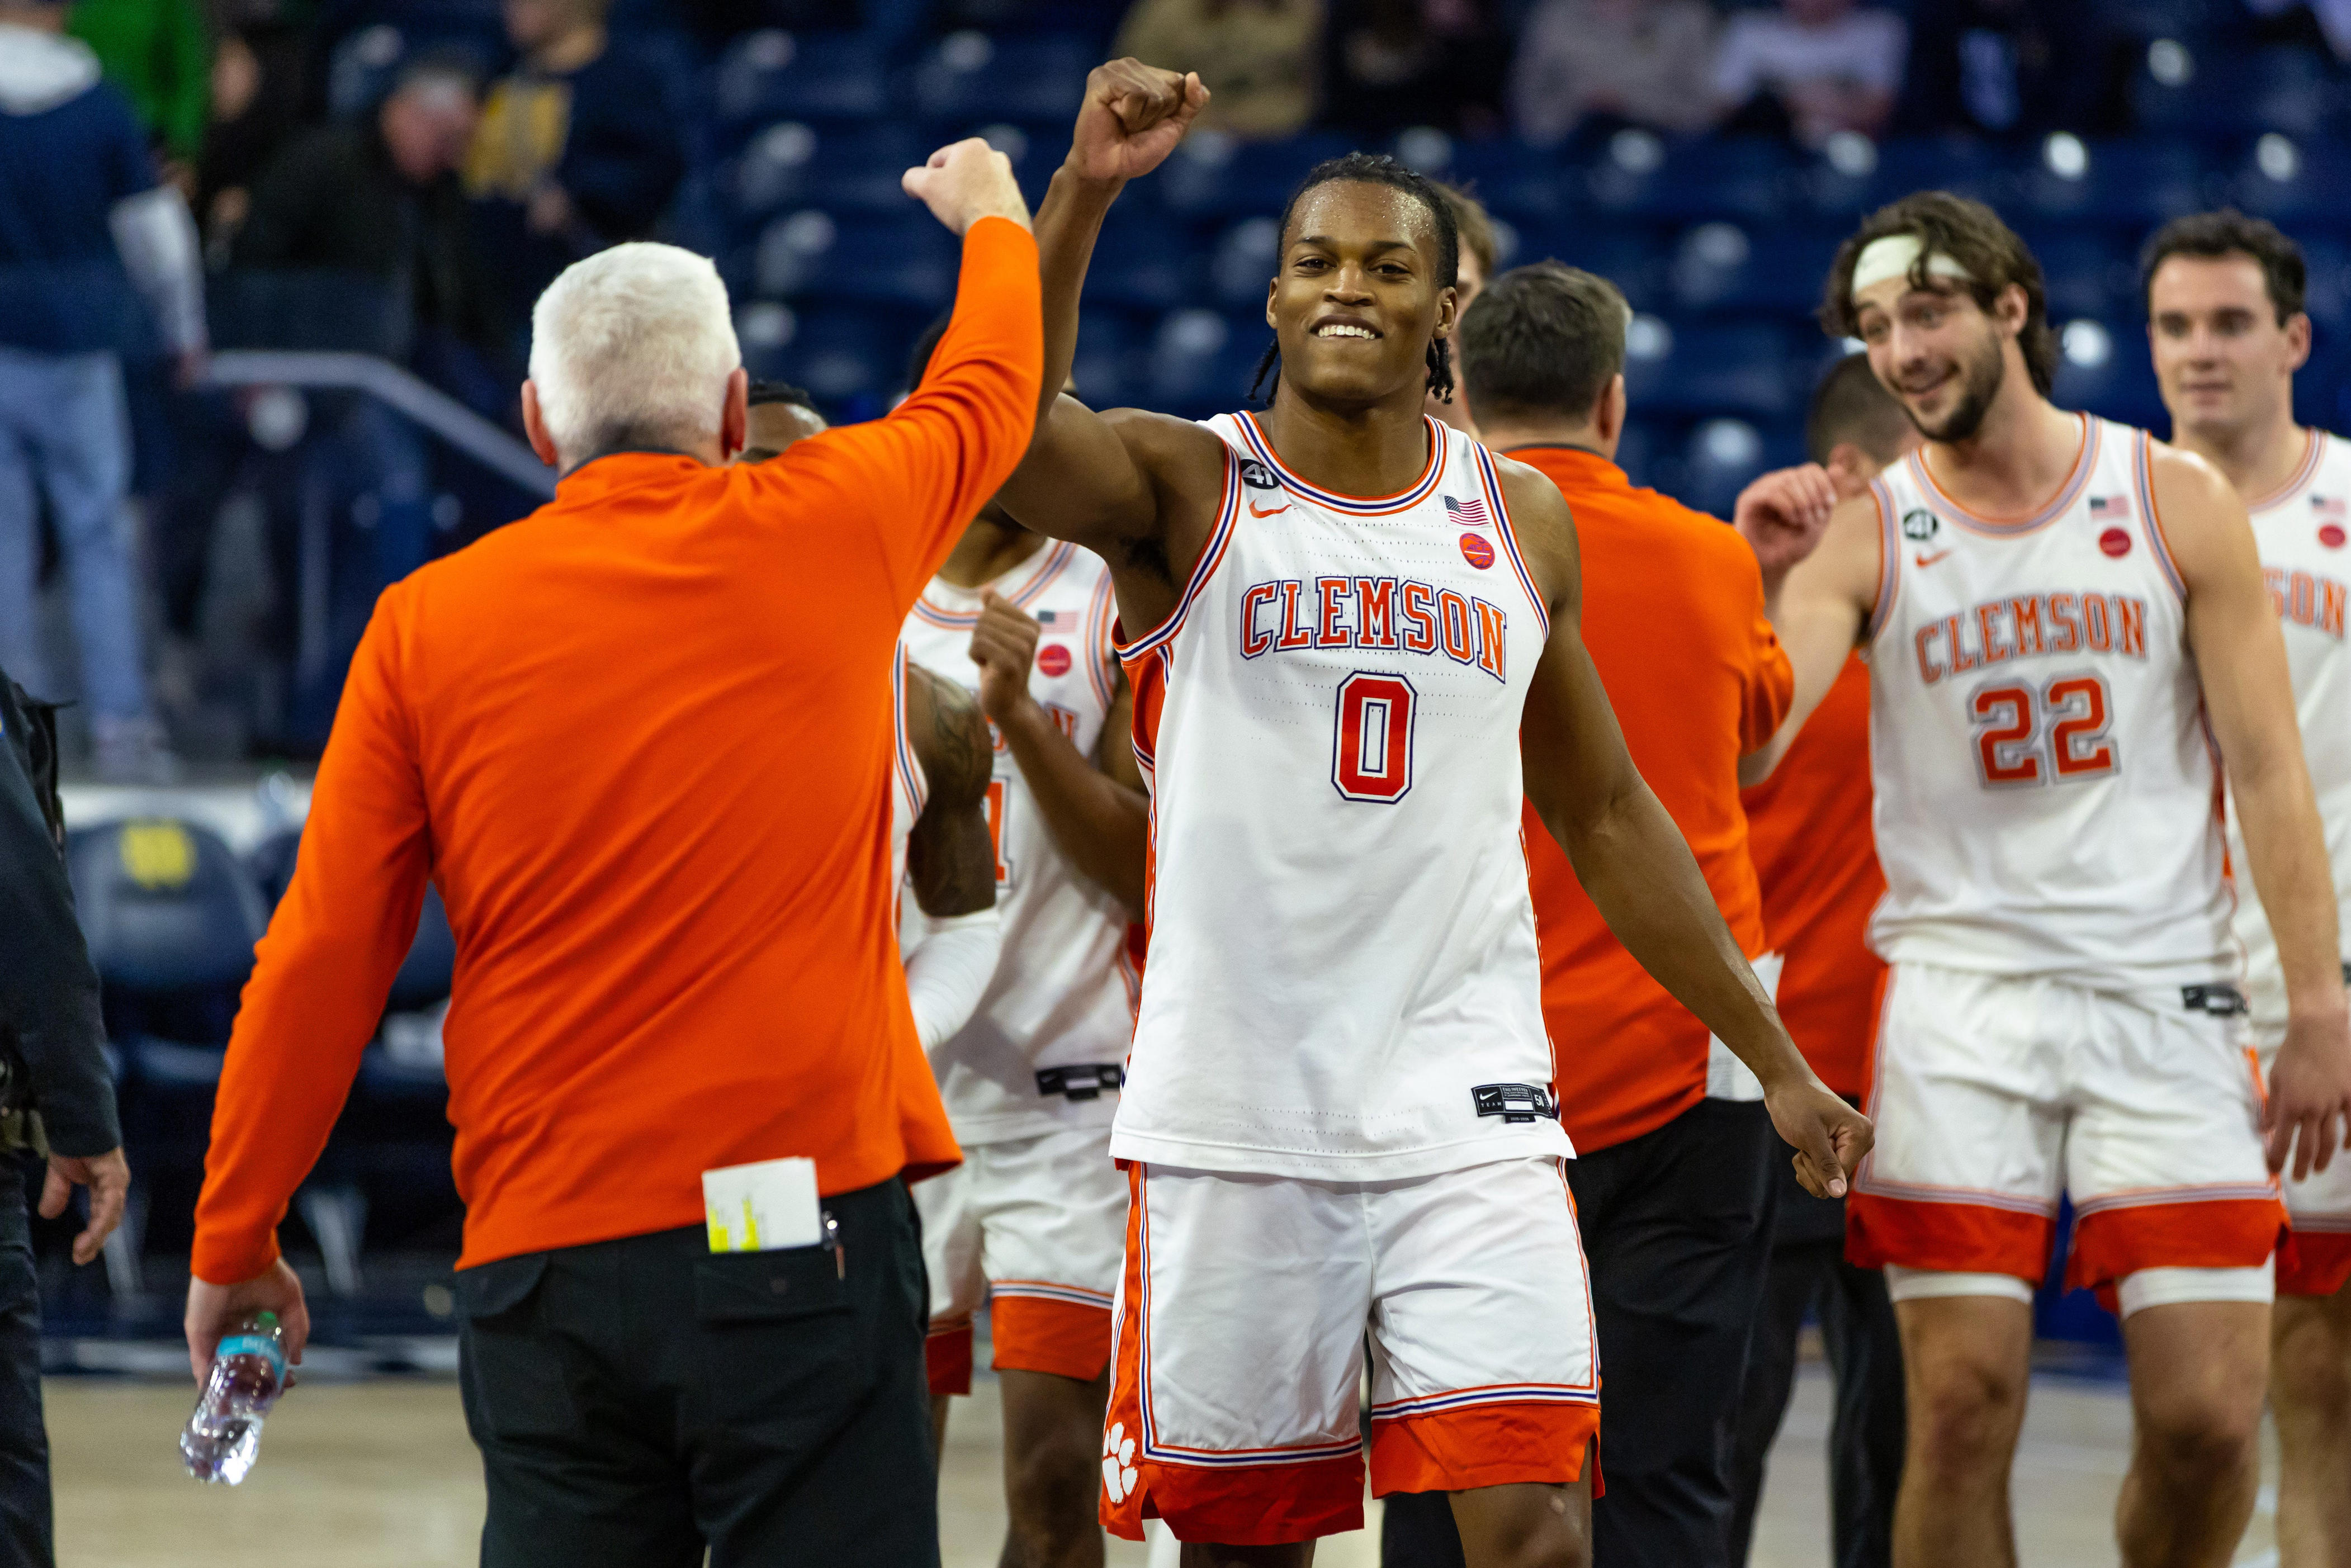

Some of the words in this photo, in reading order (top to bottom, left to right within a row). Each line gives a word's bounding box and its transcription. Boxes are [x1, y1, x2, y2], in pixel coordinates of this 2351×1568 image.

[1242, 463, 1274, 486] 41
[1240, 576, 1507, 685] CLEMSON
[1914, 590, 2149, 685] CLEMSON
[1331, 670, 1418, 804] 0
[1966, 670, 2122, 792] 22
